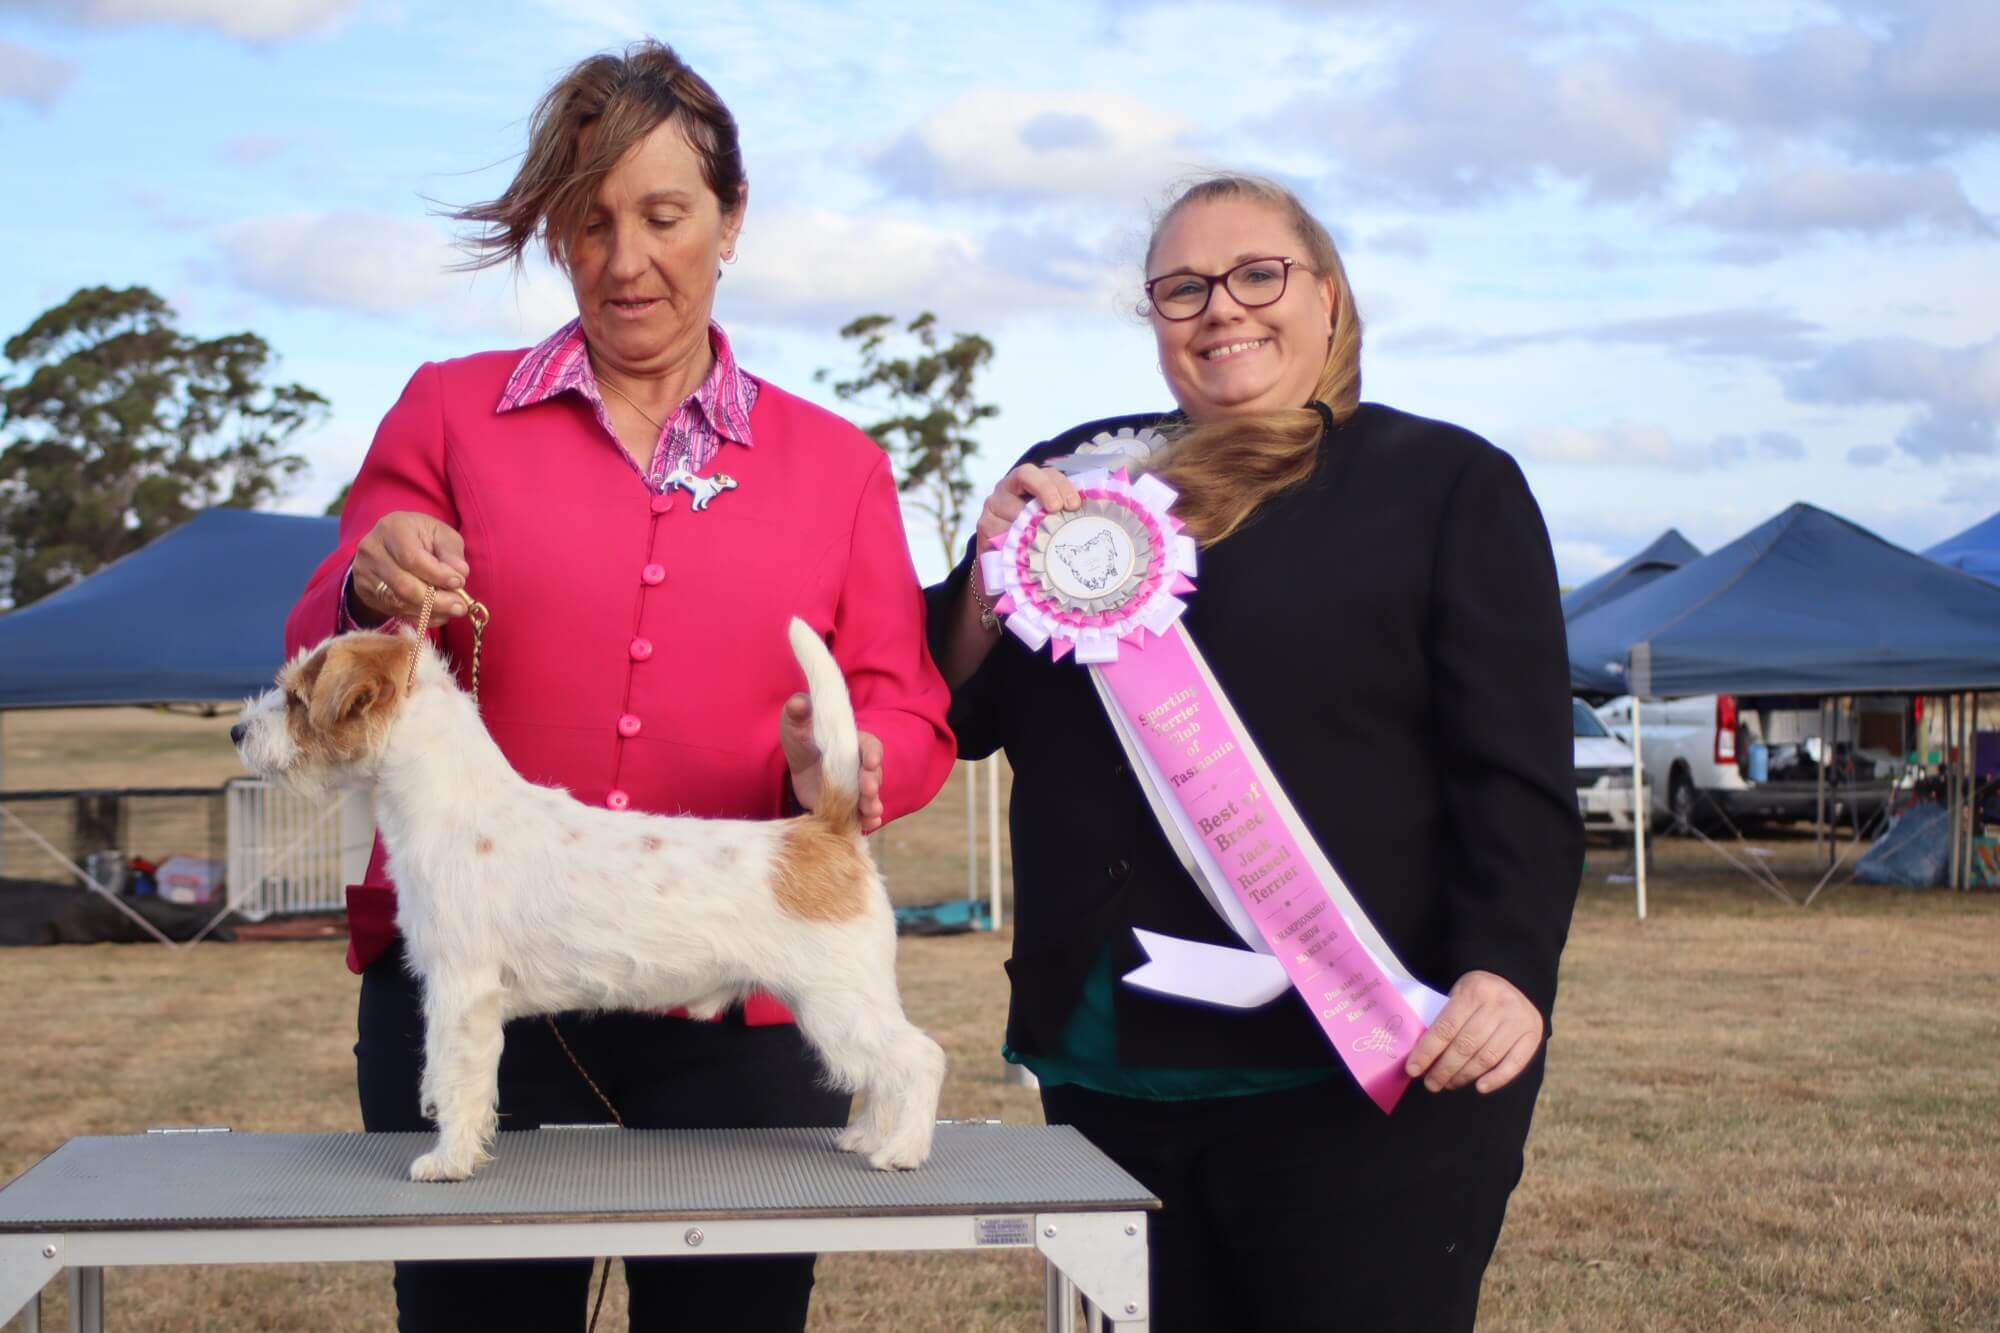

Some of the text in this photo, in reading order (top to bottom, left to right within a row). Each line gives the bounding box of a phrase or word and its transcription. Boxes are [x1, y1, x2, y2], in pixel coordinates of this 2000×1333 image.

[1138, 686, 1197, 727] Sporting
[1152, 702, 1200, 737] Terrier
[1167, 722, 1201, 745] Club
[1185, 740, 1200, 757] of
[1169, 742, 1234, 788] Tasmania
[1197, 782, 1261, 836] Best of
[1214, 809, 1265, 852] Breed
[1237, 846, 1291, 890] Russell
[1239, 838, 1272, 867] Jack
[1248, 866, 1299, 904] Terrier
